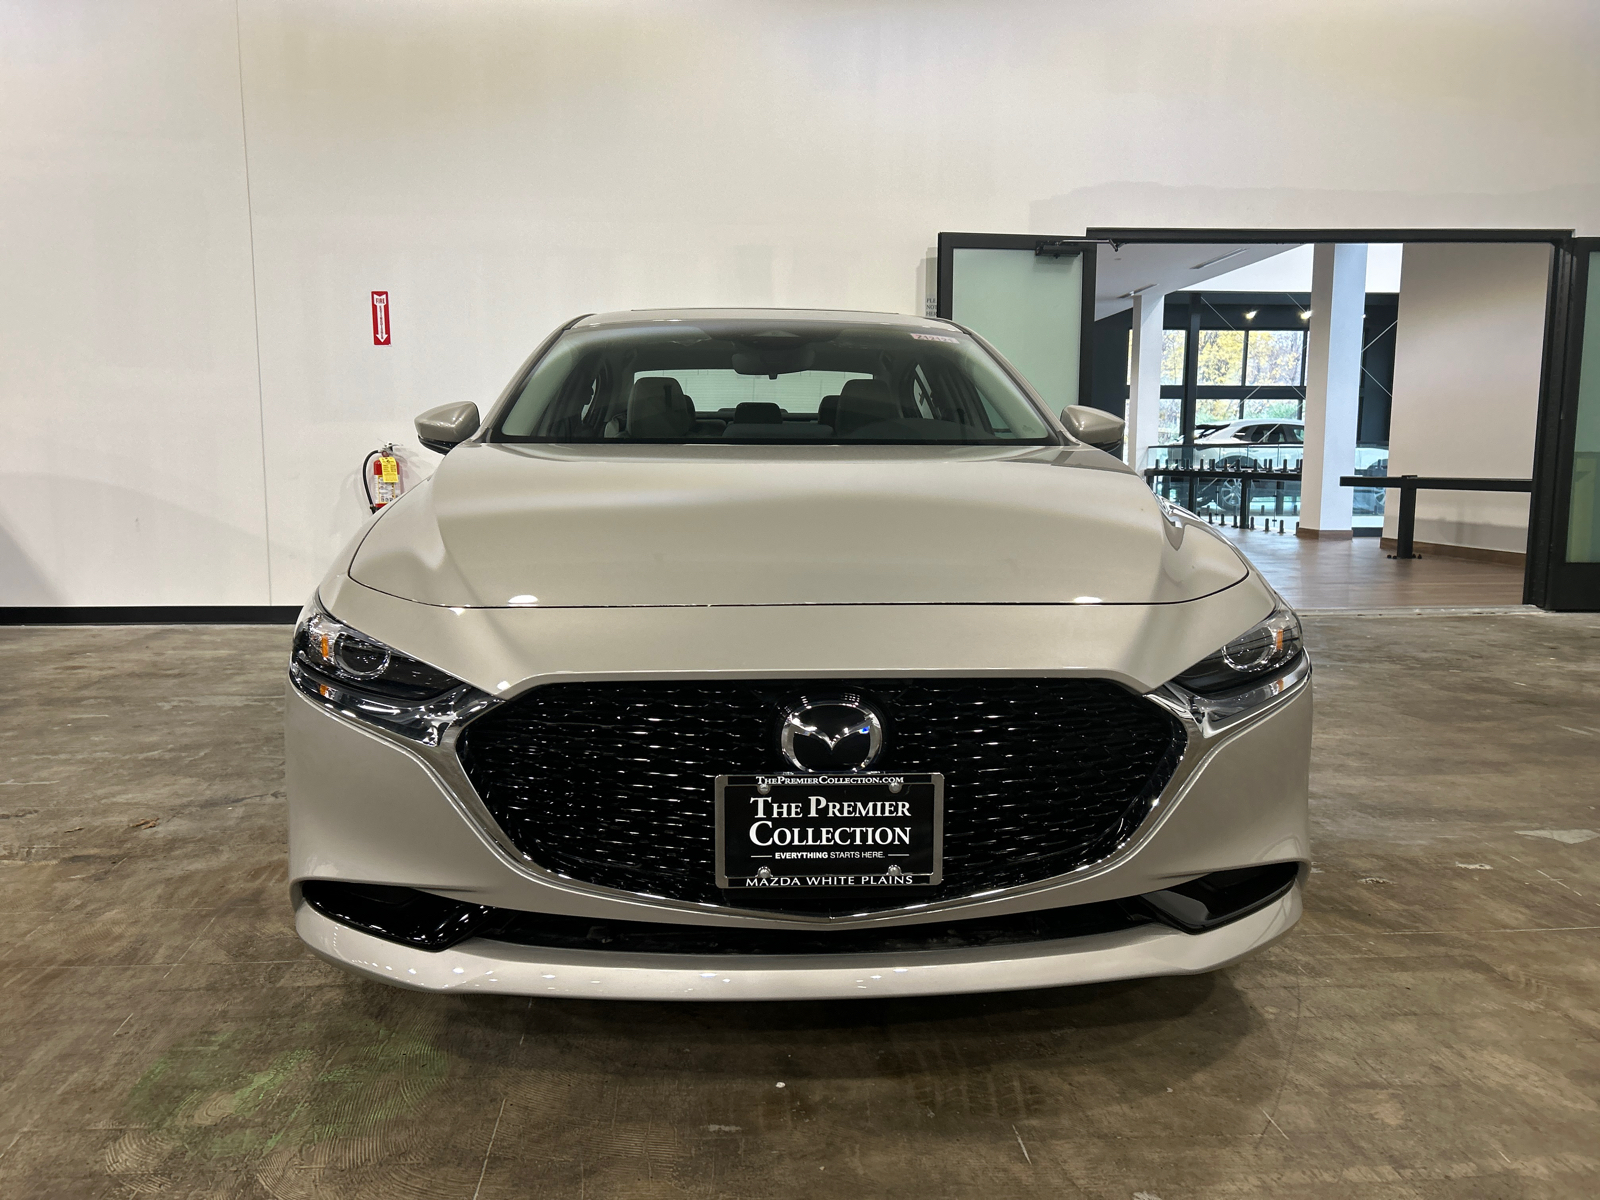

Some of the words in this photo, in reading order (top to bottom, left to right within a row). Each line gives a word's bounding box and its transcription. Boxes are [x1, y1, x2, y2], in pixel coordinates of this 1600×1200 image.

[755, 775, 905, 785] THEPREMIERCOLLECTION.COM
[749, 796, 803, 818] THE
[807, 795, 912, 817] PREMIER
[749, 820, 912, 846] COLLECTION
[775, 851, 829, 860] EVERYTHING
[829, 851, 860, 859] STARTS
[861, 851, 886, 859] HERE.
[745, 877, 801, 887] MAZDA
[806, 876, 855, 886] WHITE
[861, 875, 913, 885] PLAINS
